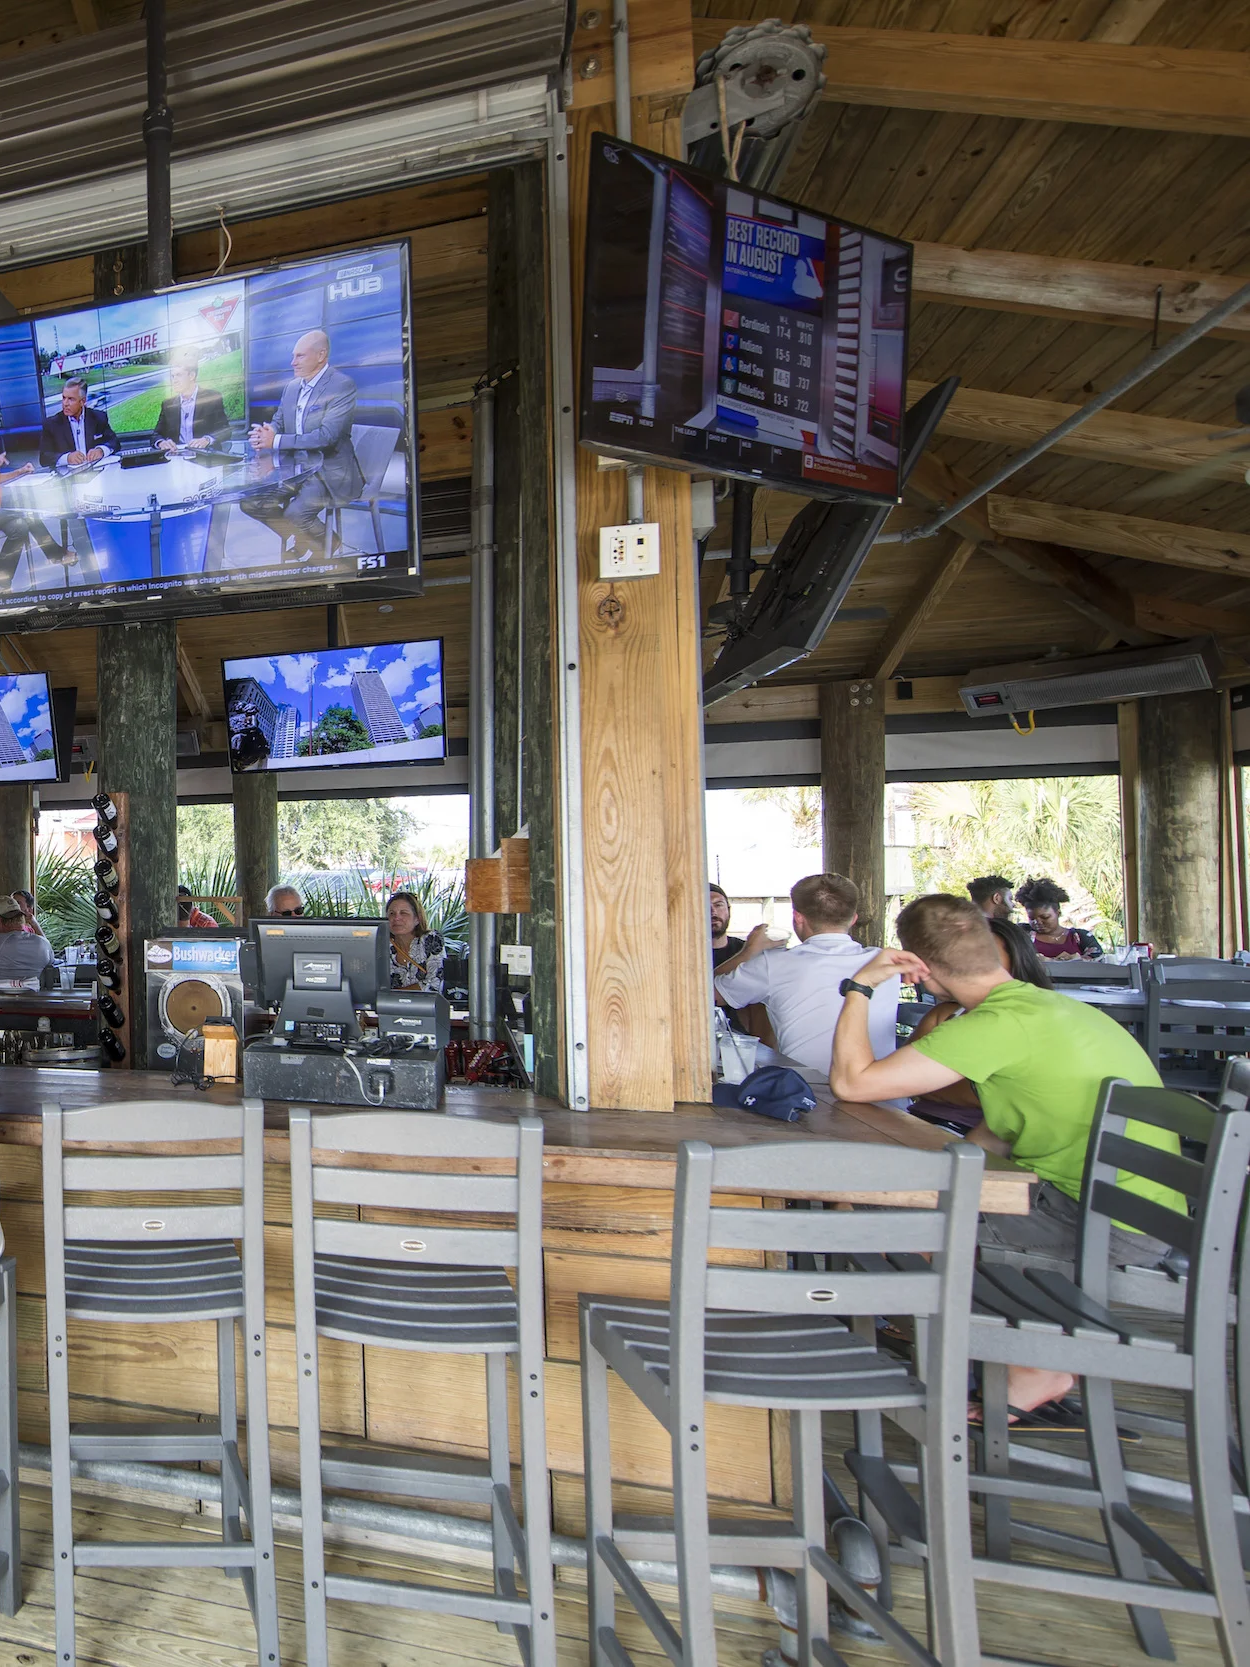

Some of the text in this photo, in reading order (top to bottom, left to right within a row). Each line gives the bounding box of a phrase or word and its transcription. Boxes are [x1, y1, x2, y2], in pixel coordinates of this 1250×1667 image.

[727, 218, 800, 256] BEST RECORD
[726, 241, 784, 275] IN AUGUST
[329, 276, 383, 302] HUB
[740, 315, 812, 345] Cardinals 17-4 .810
[89, 332, 159, 364] CANADIAN TIRE
[739, 338, 811, 368] Indians 15-5 .750
[738, 360, 810, 390] Red Sox 14-5 .737
[738, 382, 809, 413] Athletics 13-5 .722
[609, 412, 634, 426] ESPN
[639, 418, 654, 428] NEWS
[674, 426, 684, 434] THE
[685, 428, 698, 437] LEAD
[708, 433, 720, 442] OHIO
[357, 554, 386, 570] FS1
[5, 596, 38, 605] according
[39, 593, 47, 601] to
[47, 593, 64, 602] copy
[64, 591, 73, 599] of
[73, 589, 94, 598] arrest
[95, 587, 117, 596] report
[125, 584, 148, 592] which
[148, 581, 183, 591] Incognito
[199, 575, 230, 586] charged
[248, 567, 301, 579] misdemeanor
[301, 565, 334, 575] charges
[173, 946, 236, 963] Bushwacker
